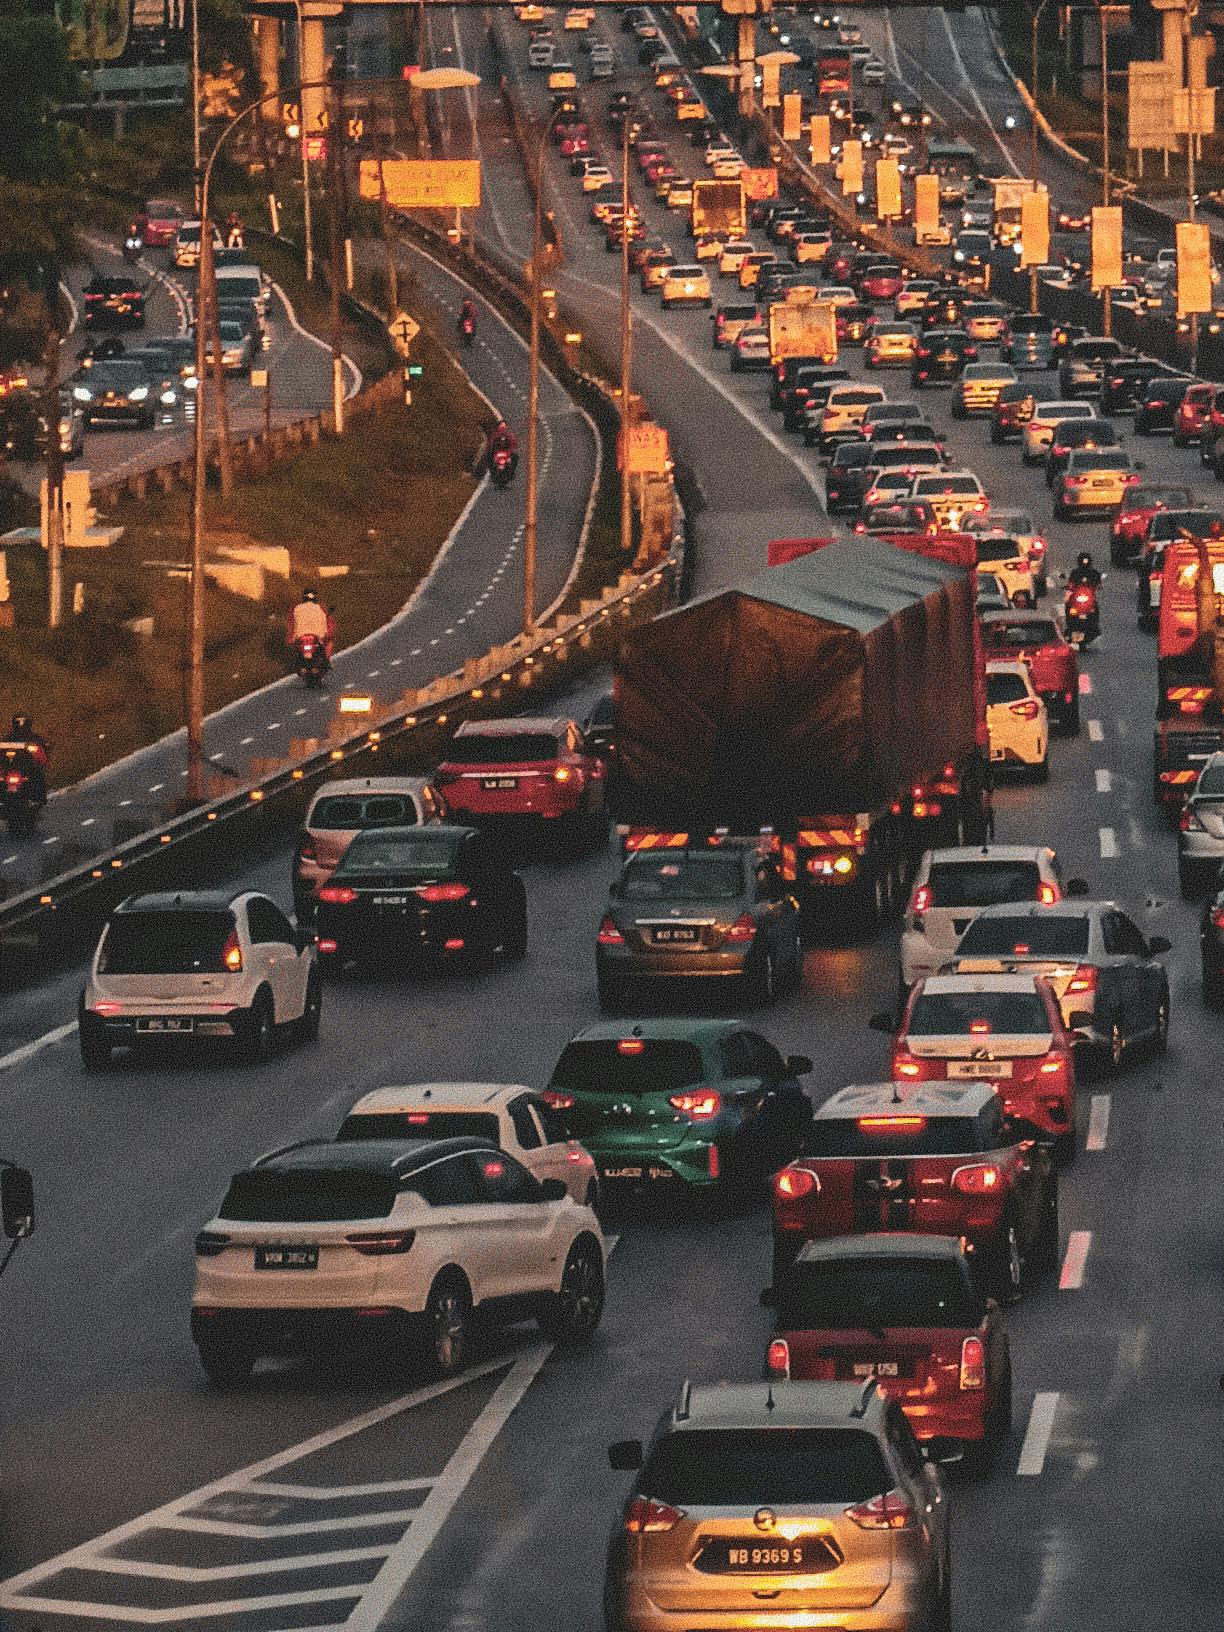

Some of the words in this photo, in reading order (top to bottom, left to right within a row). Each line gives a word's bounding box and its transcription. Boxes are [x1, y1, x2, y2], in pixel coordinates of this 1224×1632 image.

[729, 1548, 749, 1565] WB
[752, 1548, 790, 1565] 9369
[793, 1548, 803, 1565] S
